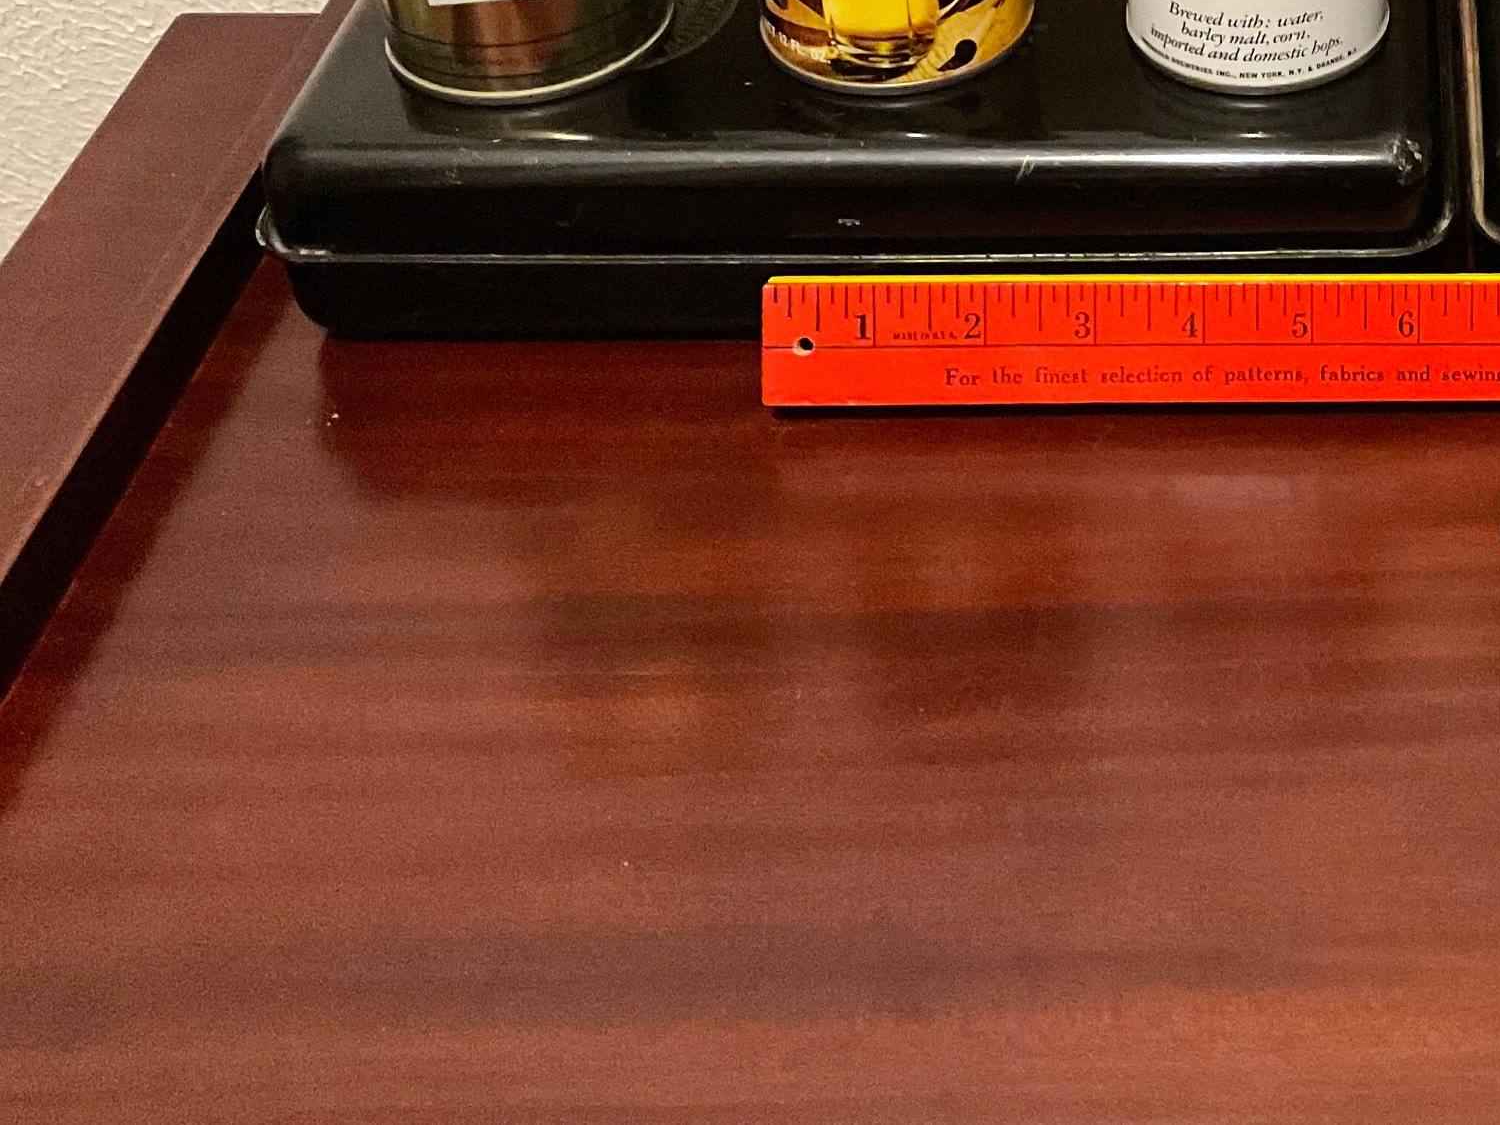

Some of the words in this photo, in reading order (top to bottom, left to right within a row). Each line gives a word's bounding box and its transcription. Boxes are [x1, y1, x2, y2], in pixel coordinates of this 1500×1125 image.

[1168, 1, 1224, 26] Brewed
[1227, 13, 1270, 29] with:
[1150, 27, 1205, 57] imported
[1207, 48, 1241, 62] and
[1242, 44, 1309, 63] domestic
[1311, 36, 1343, 57] hops.
[1181, 21, 1226, 47] barley
[1229, 30, 1270, 46] malt,
[854, 313, 868, 339] 1
[963, 313, 982, 339] 2
[1073, 312, 1091, 338] 3
[1181, 313, 1198, 338] 4
[1291, 312, 1308, 338] 5
[1398, 311, 1414, 337] 6
[945, 368, 980, 385] For
[993, 368, 1022, 384] the
[1035, 366, 1087, 384] finest
[1101, 366, 1182, 384] selection
[1193, 365, 1213, 383] of
[1224, 366, 1309, 386] patterns,
[1320, 364, 1384, 382] fabrics
[1396, 364, 1431, 382] and
